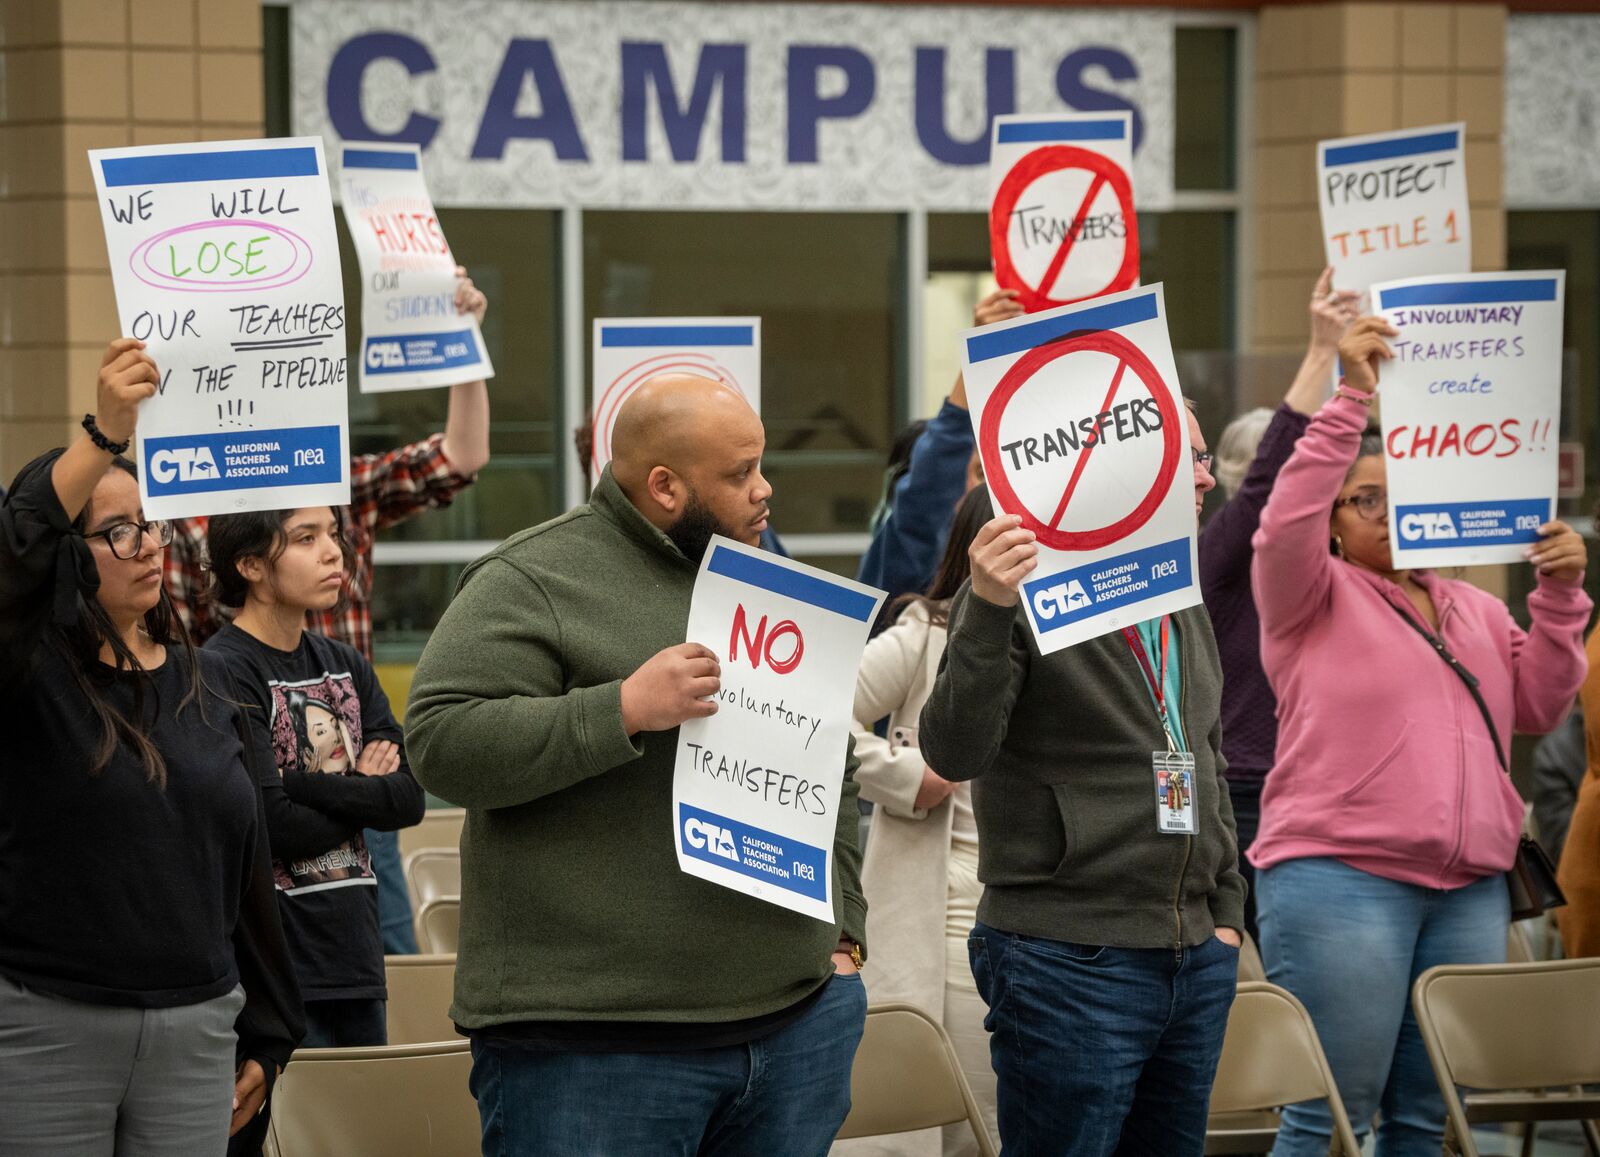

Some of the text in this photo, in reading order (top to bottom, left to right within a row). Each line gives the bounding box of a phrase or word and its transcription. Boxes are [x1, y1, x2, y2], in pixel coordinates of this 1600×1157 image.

[327, 31, 1144, 167] CAMPUS
[1326, 160, 1456, 206] PROTECT
[108, 188, 300, 225] WE WILL
[368, 213, 448, 254] HURTS
[1331, 208, 1461, 257] TITLE 1
[170, 236, 271, 277] LOSE
[132, 303, 344, 341] OUR TEACHERS
[1393, 305, 1524, 327] INVOLUNTARY
[367, 341, 405, 368] CTA
[1394, 335, 1526, 363] TRANSFERS
[192, 364, 238, 394] THE
[261, 356, 347, 389] PIPELINE
[1428, 373, 1494, 395] create
[1000, 397, 1164, 471] TRANSFERS
[150, 441, 325, 484] CTA CALIFORNIA nea
[225, 454, 271, 466] TEACHERS
[225, 465, 289, 478] ASSOCIATION
[1400, 510, 1541, 541] CTA CALIFORNIA nea
[1460, 519, 1499, 528] TEACHERS
[1461, 527, 1514, 538] ASSOCIATION
[1033, 559, 1178, 620] CTA CALIFORNIA nea
[1093, 574, 1132, 592] TEACHERS
[1096, 580, 1149, 603] ASSOCIATION
[729, 603, 805, 675] NO
[712, 687, 821, 750] voluntary
[687, 742, 826, 815] TRANSFERS
[684, 817, 783, 862] CTA CALIFORNIA
[742, 846, 777, 864] TEACHERS
[743, 857, 815, 882] ASSOCIATION nea
